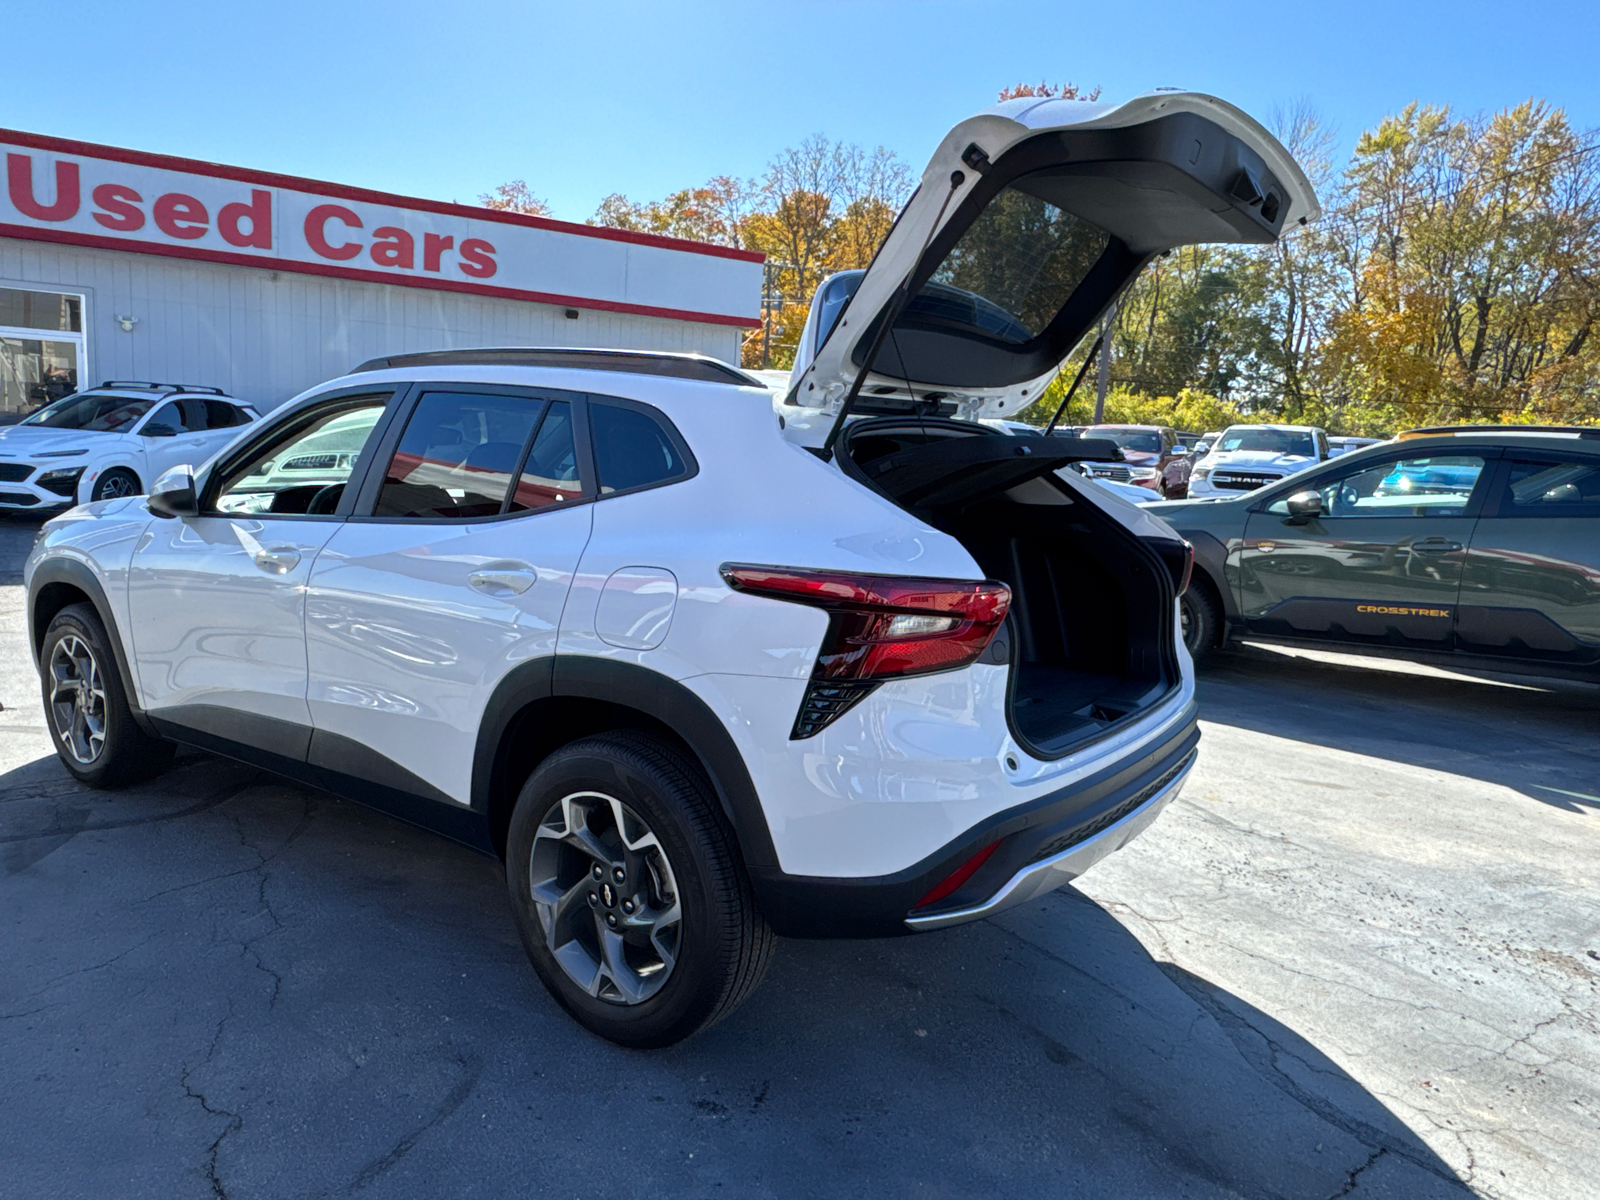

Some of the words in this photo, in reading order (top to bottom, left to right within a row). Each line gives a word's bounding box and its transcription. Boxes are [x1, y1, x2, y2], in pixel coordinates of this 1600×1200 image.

[7, 153, 272, 249] Used
[304, 204, 498, 279] Cars
[1356, 605, 1450, 617] CROSSTREK
